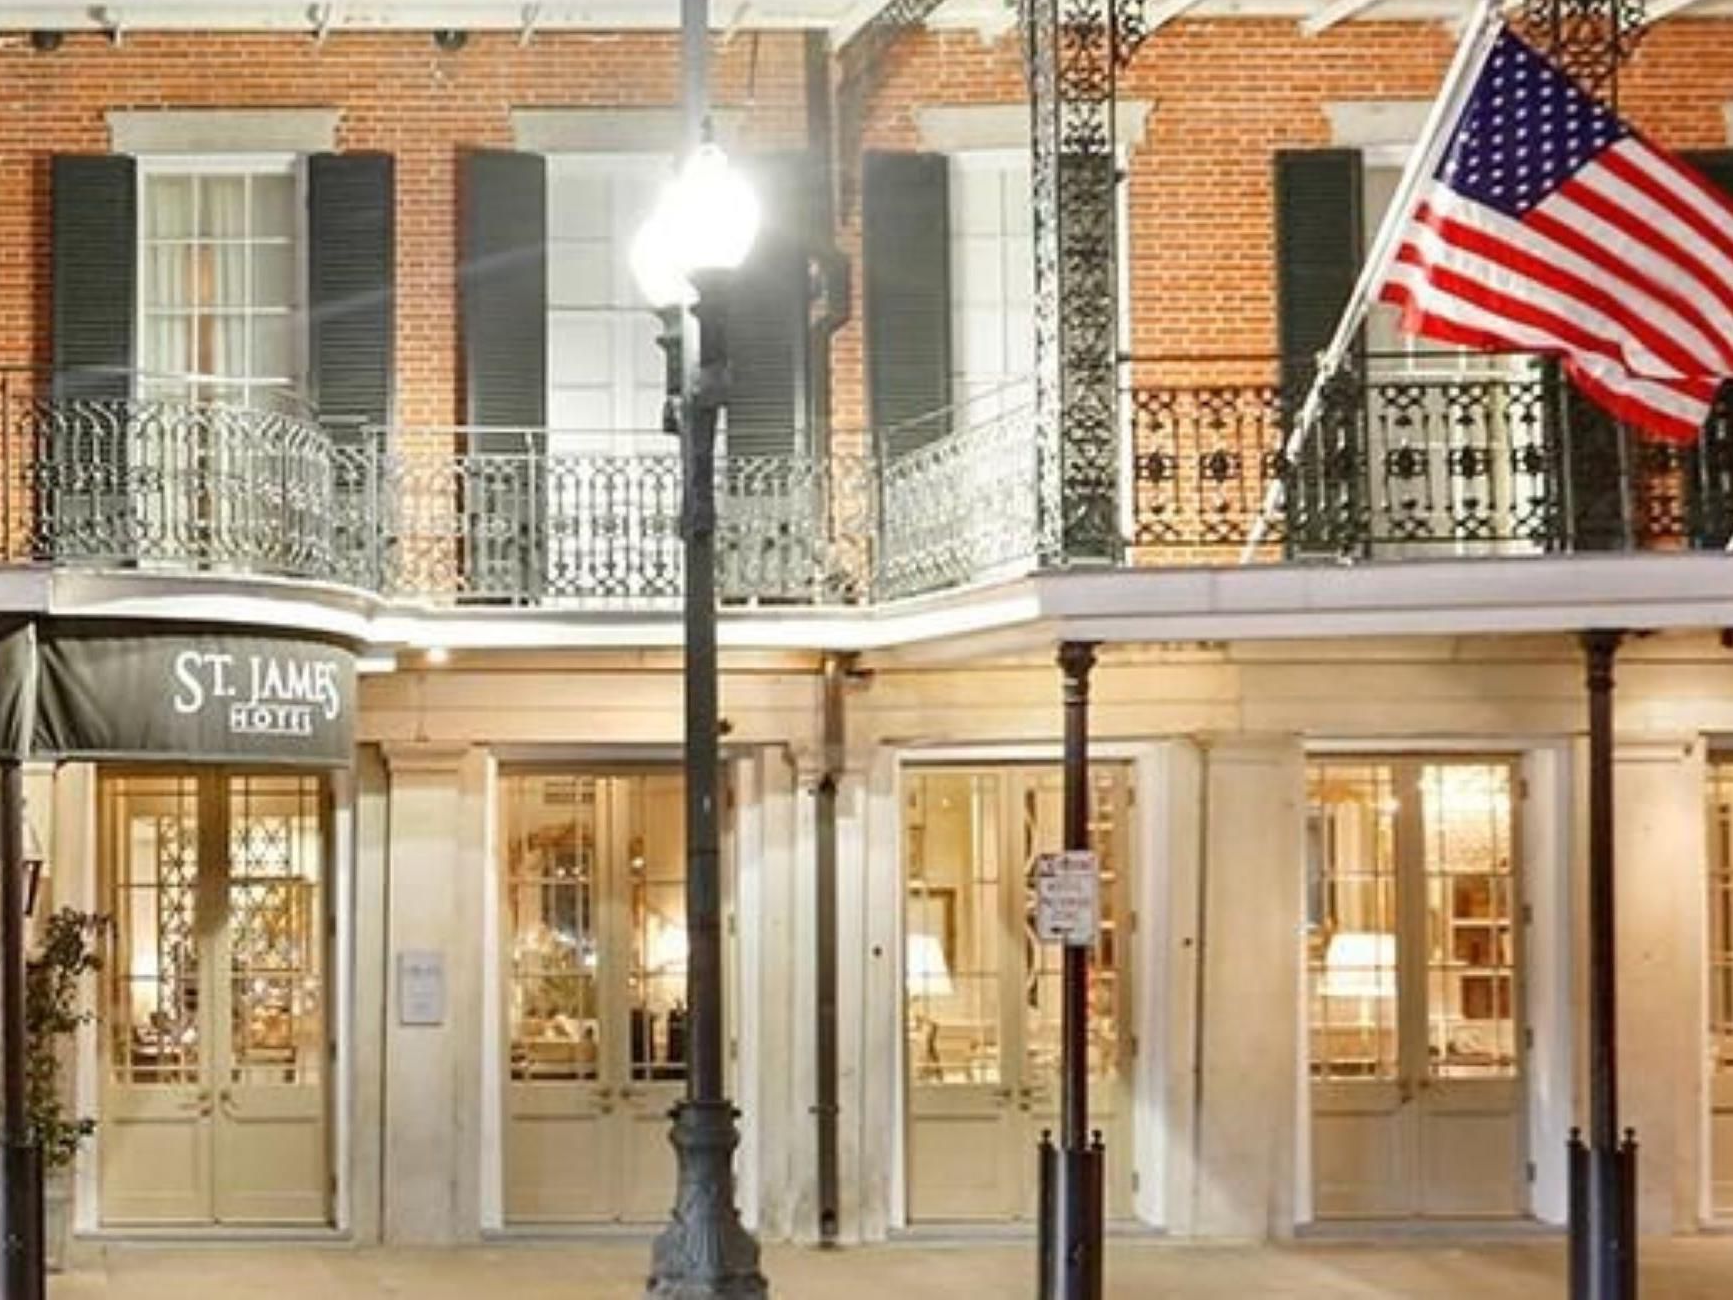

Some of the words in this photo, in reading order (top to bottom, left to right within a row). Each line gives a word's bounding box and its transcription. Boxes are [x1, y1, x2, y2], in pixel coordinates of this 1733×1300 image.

[174, 651, 236, 714] ST.
[247, 657, 340, 720] JAMES
[230, 706, 312, 732] HOTEL
